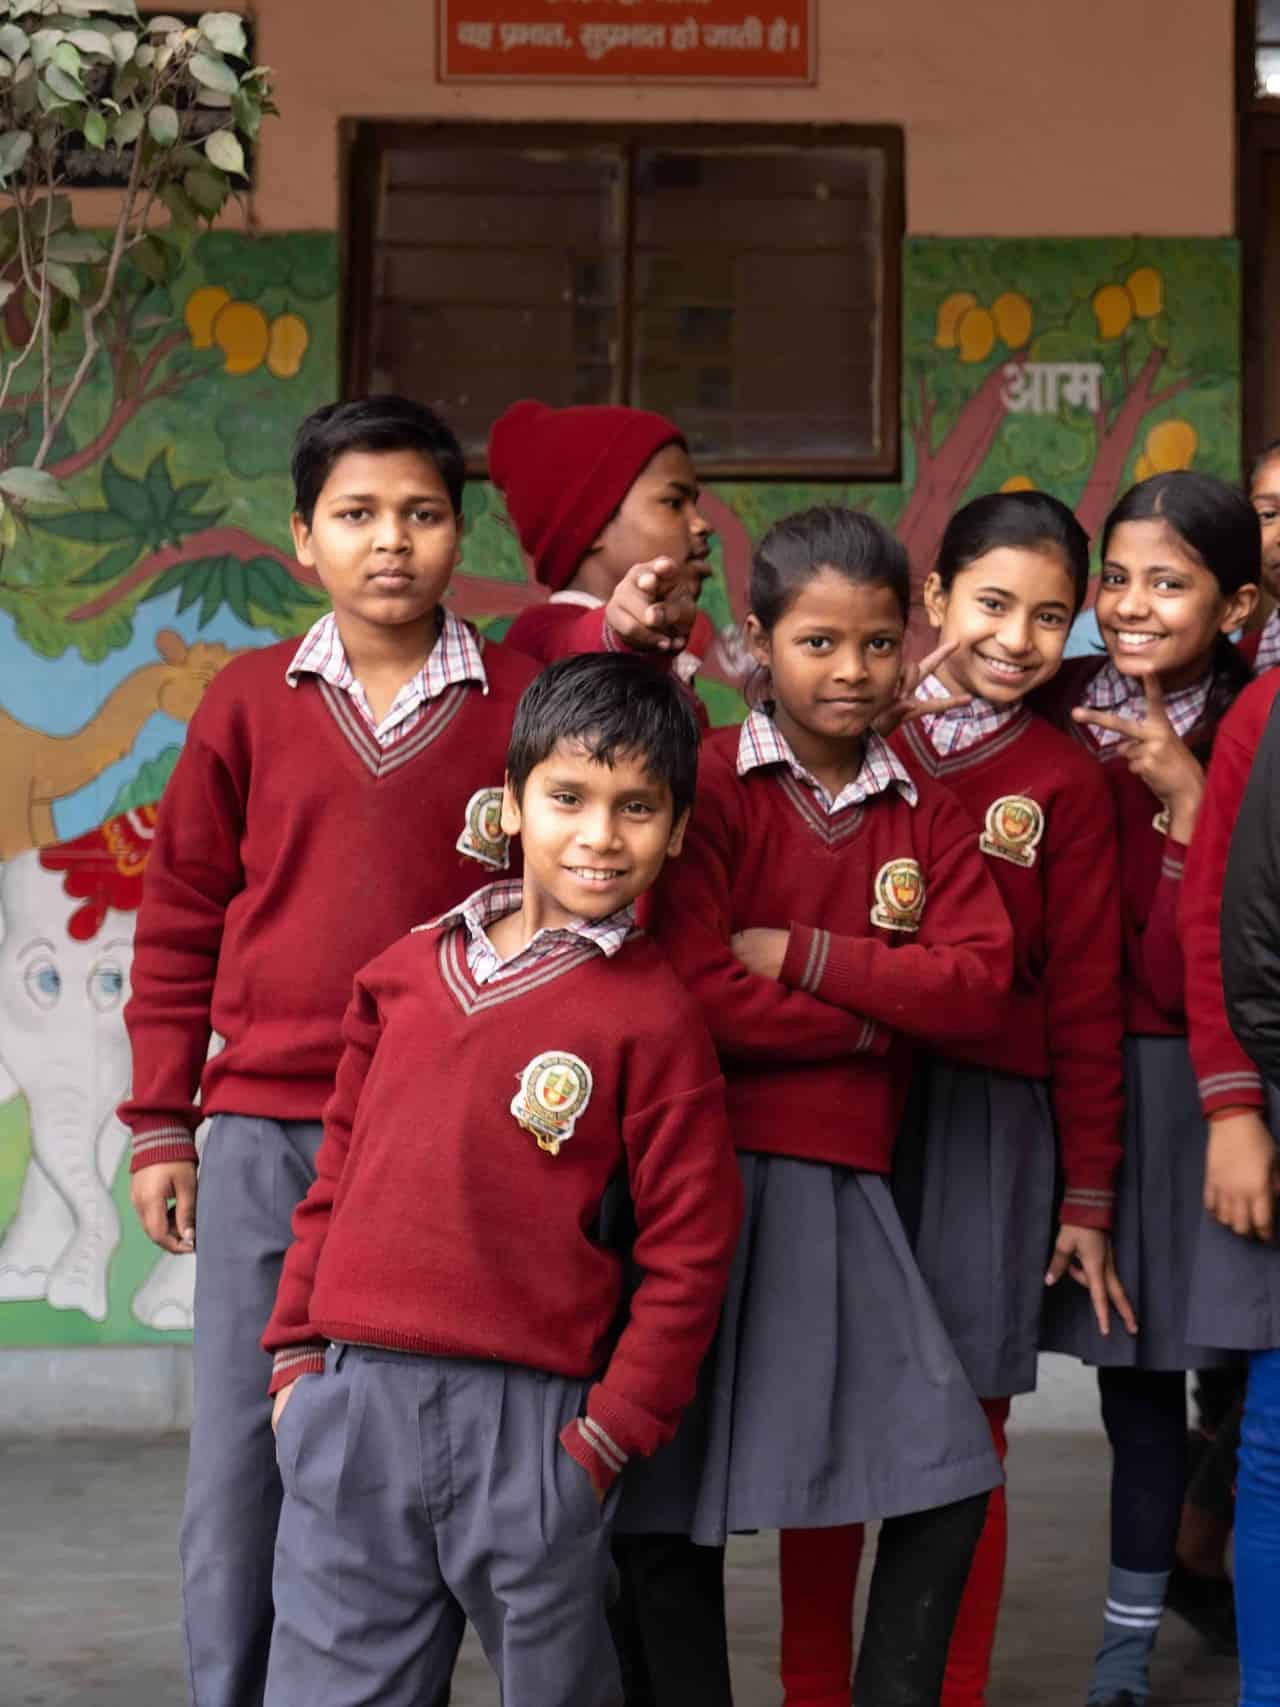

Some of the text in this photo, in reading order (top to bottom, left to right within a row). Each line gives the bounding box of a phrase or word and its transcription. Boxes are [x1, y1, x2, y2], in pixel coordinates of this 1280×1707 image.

[578, 22, 666, 60] सुप्रभात
[671, 16, 700, 51] हो
[703, 16, 763, 50] जाती
[1002, 362, 1104, 413] आम
